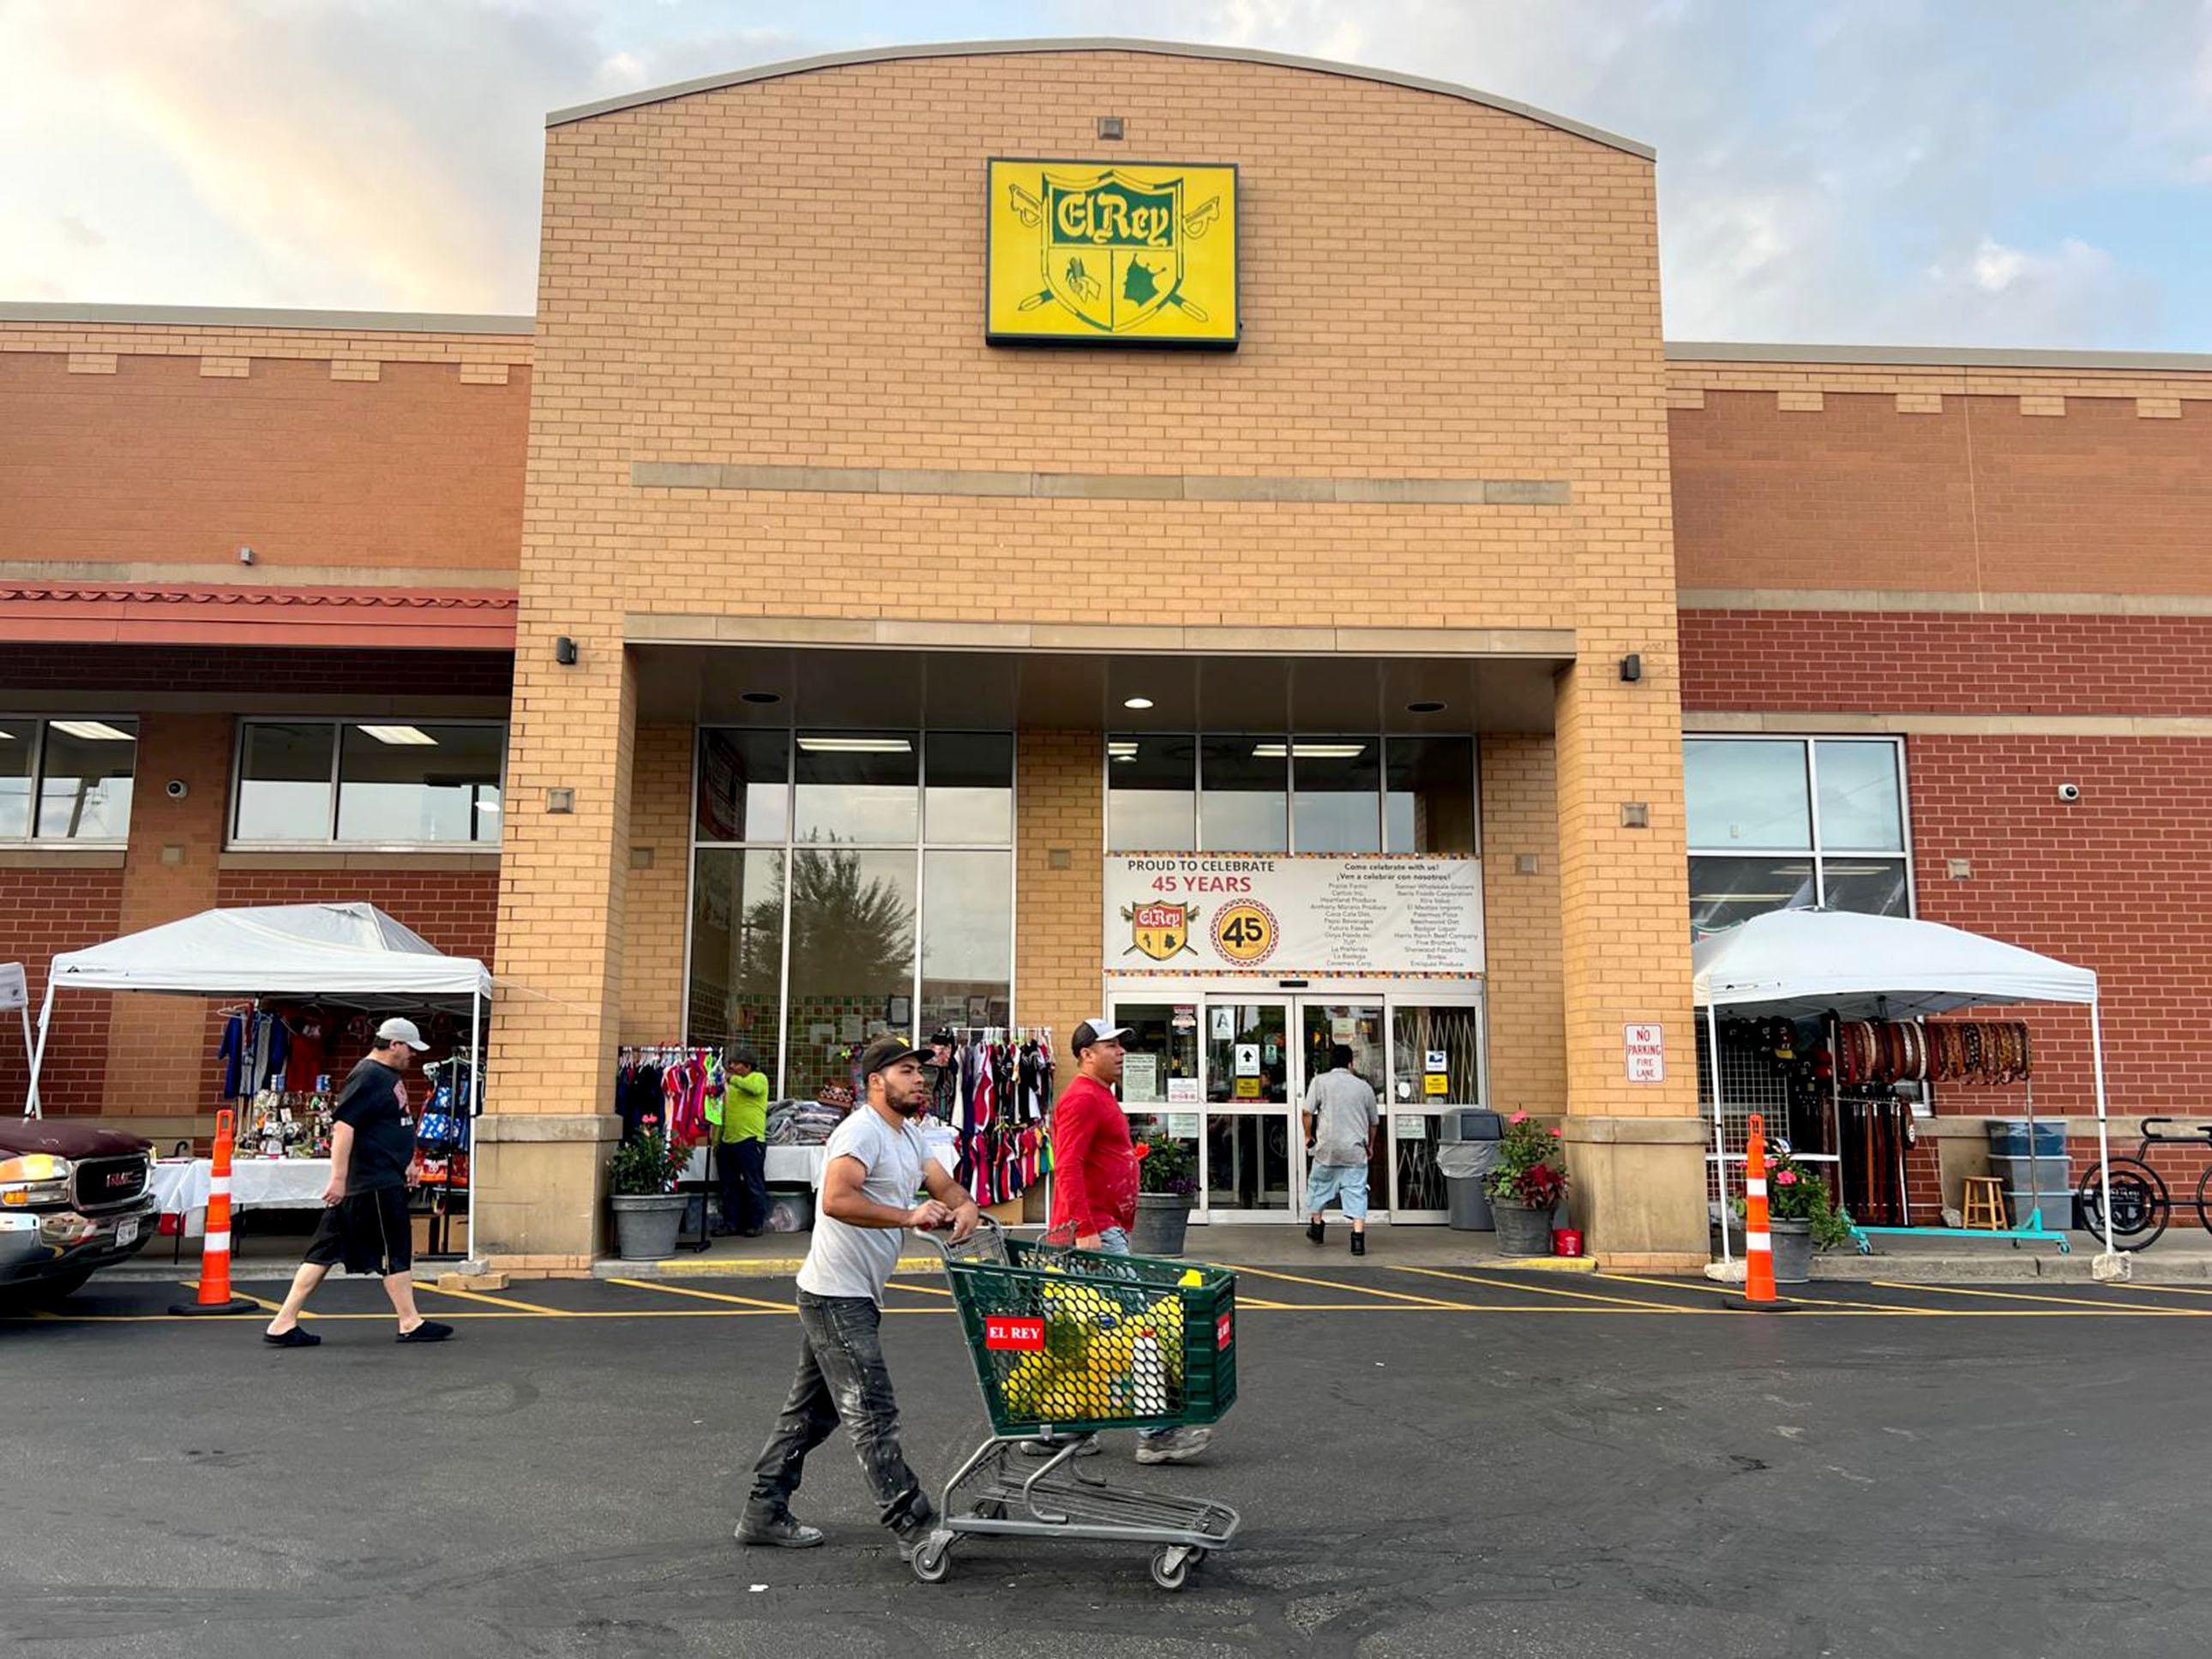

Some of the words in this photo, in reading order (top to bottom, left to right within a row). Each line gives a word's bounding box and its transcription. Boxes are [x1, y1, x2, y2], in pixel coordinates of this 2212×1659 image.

[1128, 860, 1175, 871] PROUD
[1181, 860, 1198, 871] TO
[1201, 860, 1275, 872] CELEBRATE
[1428, 863, 1440, 872] us!
[1151, 875, 1177, 892] 45
[1183, 876, 1252, 893] YEARS
[1222, 917, 1263, 948] 45
[1637, 1030, 1650, 1042] NO
[1628, 1044, 1662, 1055] PARKING
[1637, 1058, 1653, 1067] FIRE
[1637, 1069, 1654, 1078] LANE
[989, 1326, 1008, 1339] EL
[1011, 1327, 1041, 1340] REY
